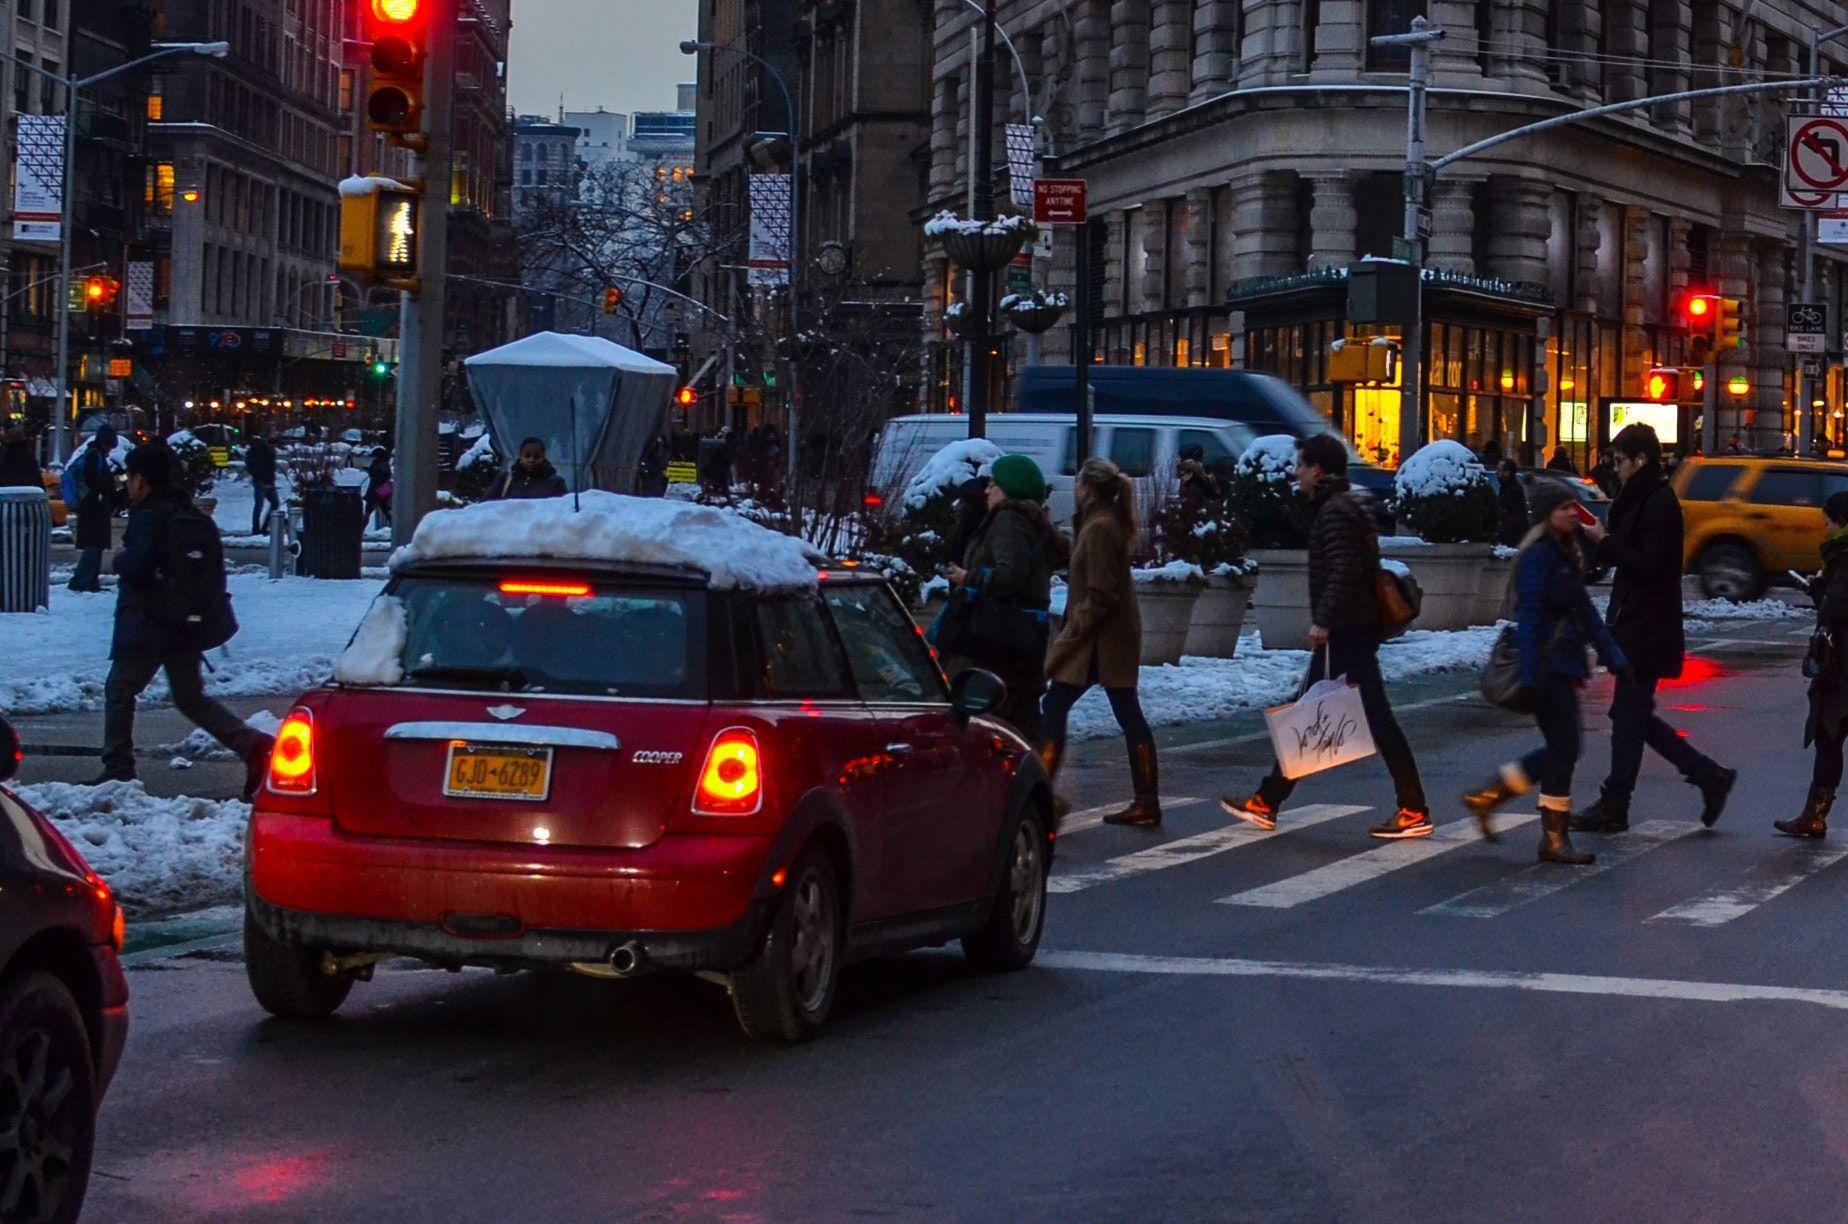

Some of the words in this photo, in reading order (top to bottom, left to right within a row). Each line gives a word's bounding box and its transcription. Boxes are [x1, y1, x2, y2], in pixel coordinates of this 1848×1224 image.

[1038, 185, 1049, 194] NO
[1050, 185, 1082, 194] STOPPING
[1045, 197, 1075, 206] ANYTIME
[632, 750, 684, 764] COOPER
